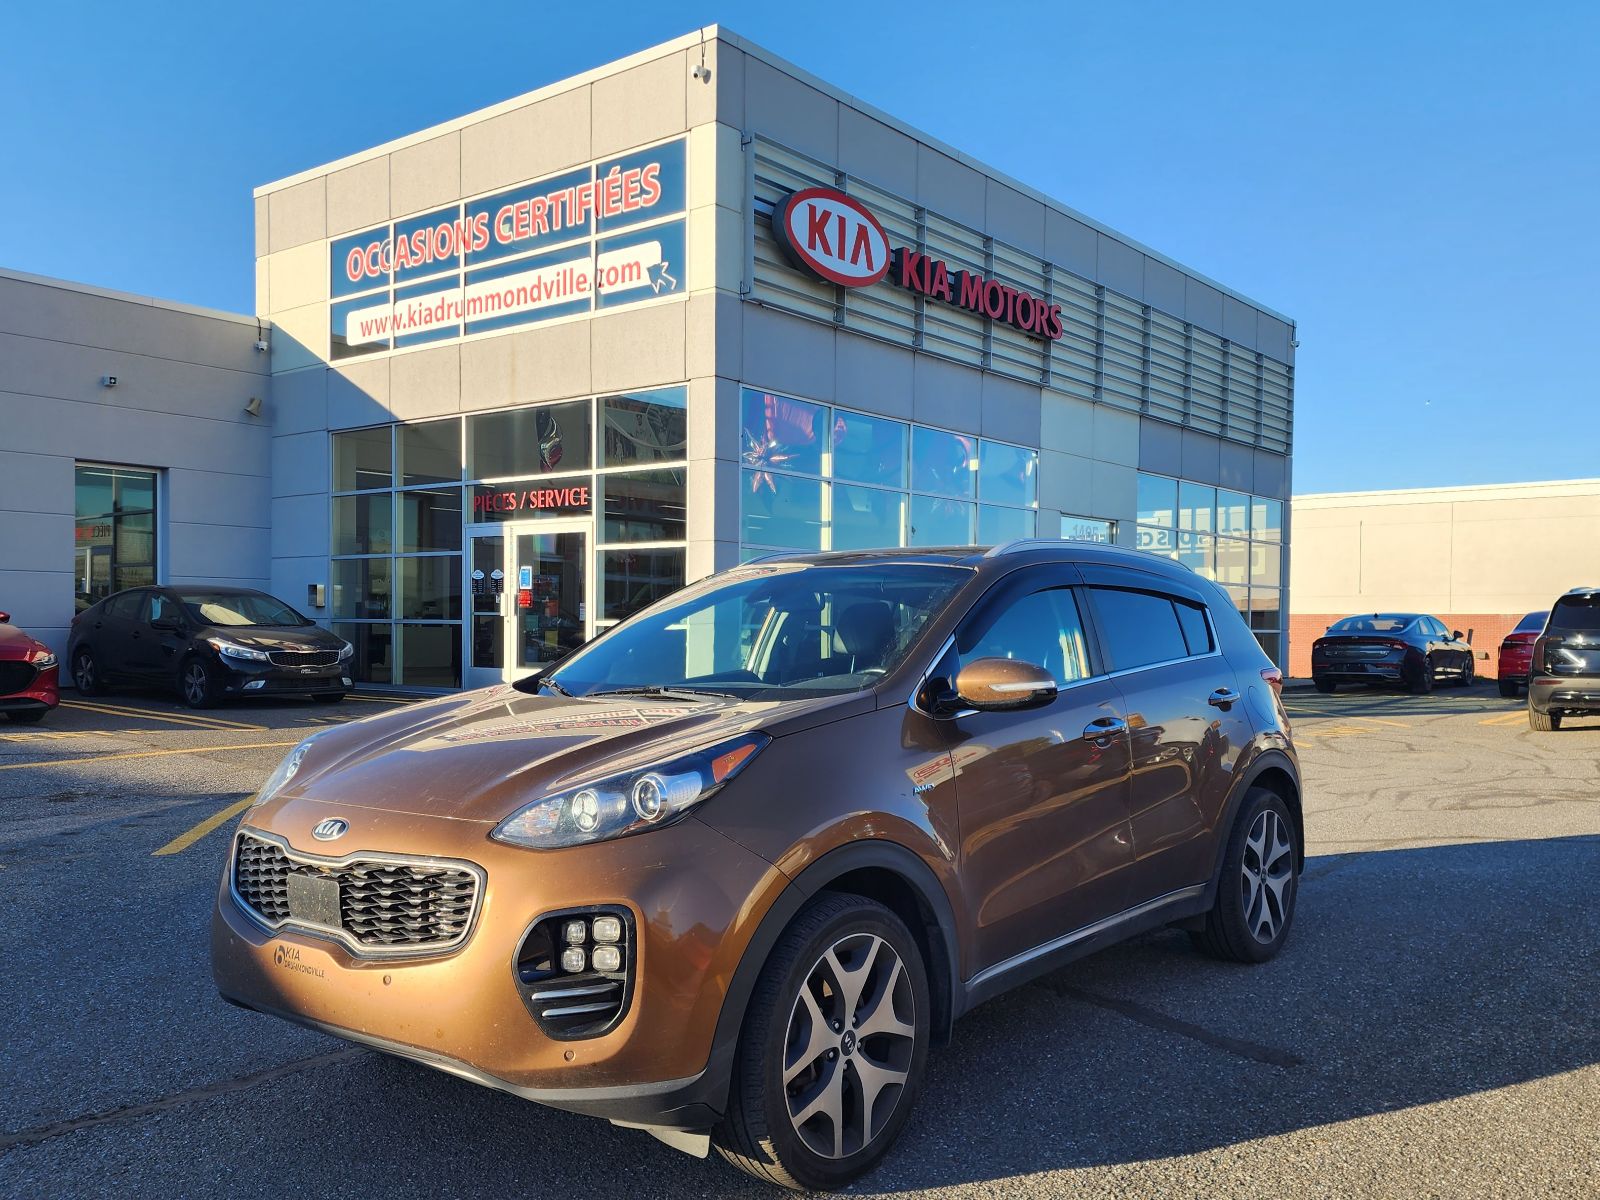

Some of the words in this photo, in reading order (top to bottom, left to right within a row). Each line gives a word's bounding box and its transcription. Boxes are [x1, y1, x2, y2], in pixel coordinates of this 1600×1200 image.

[347, 211, 490, 281] OCCASIONS
[494, 162, 661, 245] CERTIFIÉES
[807, 203, 875, 271] KIA
[360, 259, 642, 338] www.kiadrummondville.com
[902, 248, 951, 302] KIA
[960, 271, 1063, 340] MOTORS
[473, 491, 517, 512] PIÈCES
[529, 487, 588, 509] SERVICE
[314, 819, 343, 836] KIA
[285, 946, 301, 961] KIA
